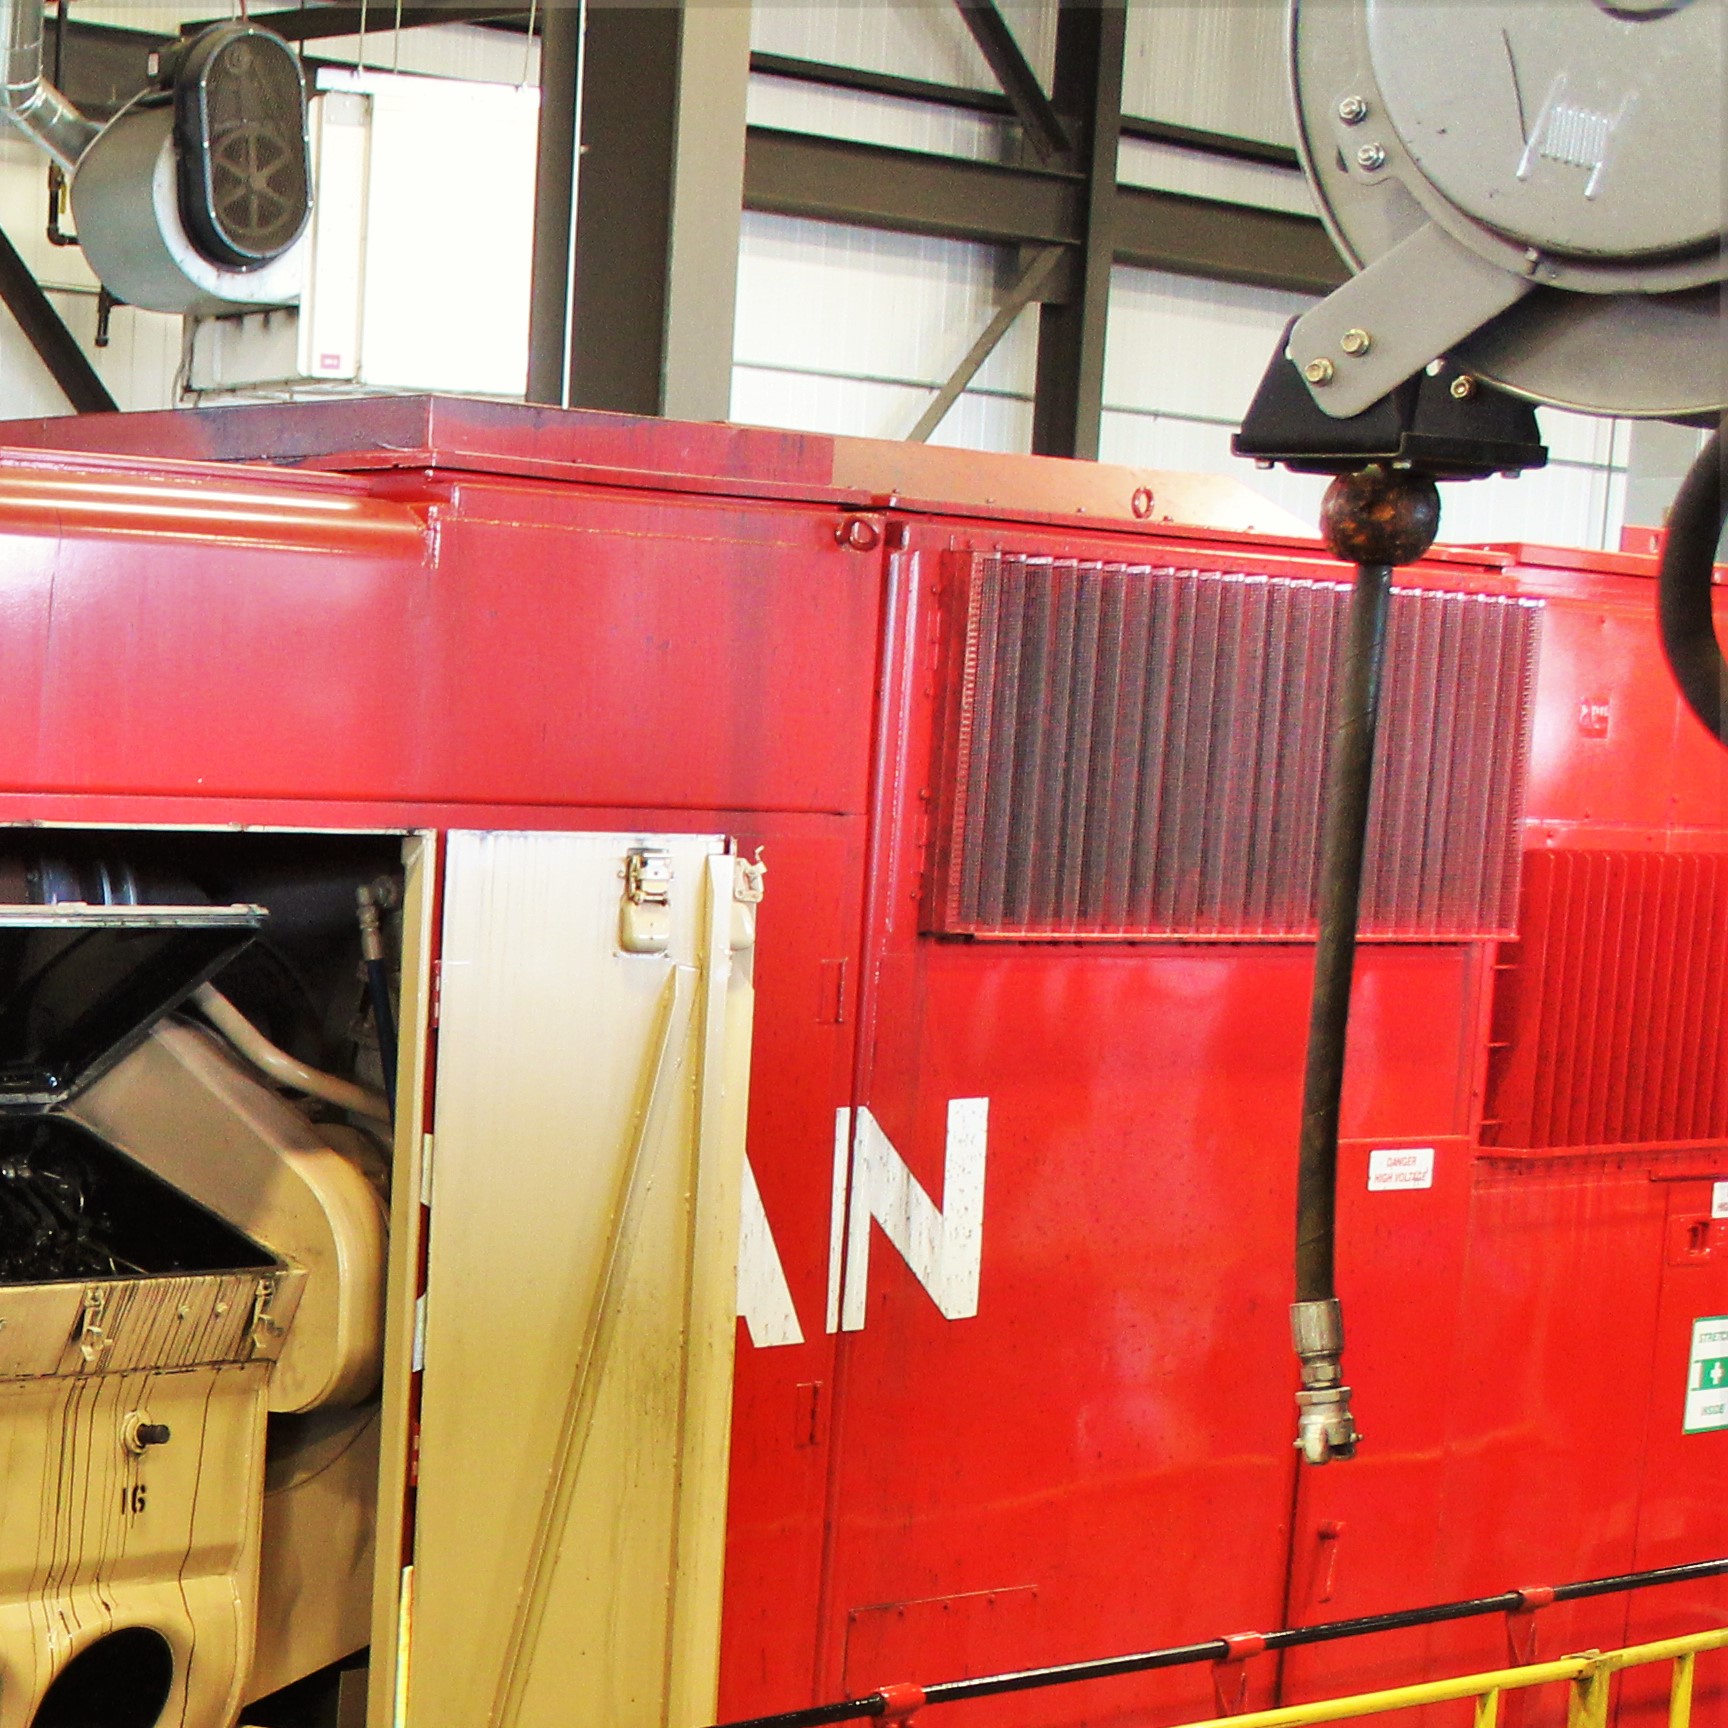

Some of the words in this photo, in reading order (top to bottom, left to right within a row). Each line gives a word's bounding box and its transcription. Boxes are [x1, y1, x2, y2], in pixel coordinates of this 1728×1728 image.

[1387, 1156, 1416, 1167] DANGER
[1375, 1173, 1393, 1182] HIGH
[1395, 1171, 1427, 1182] VOLTAGE
[119, 1483, 148, 1516] 16
